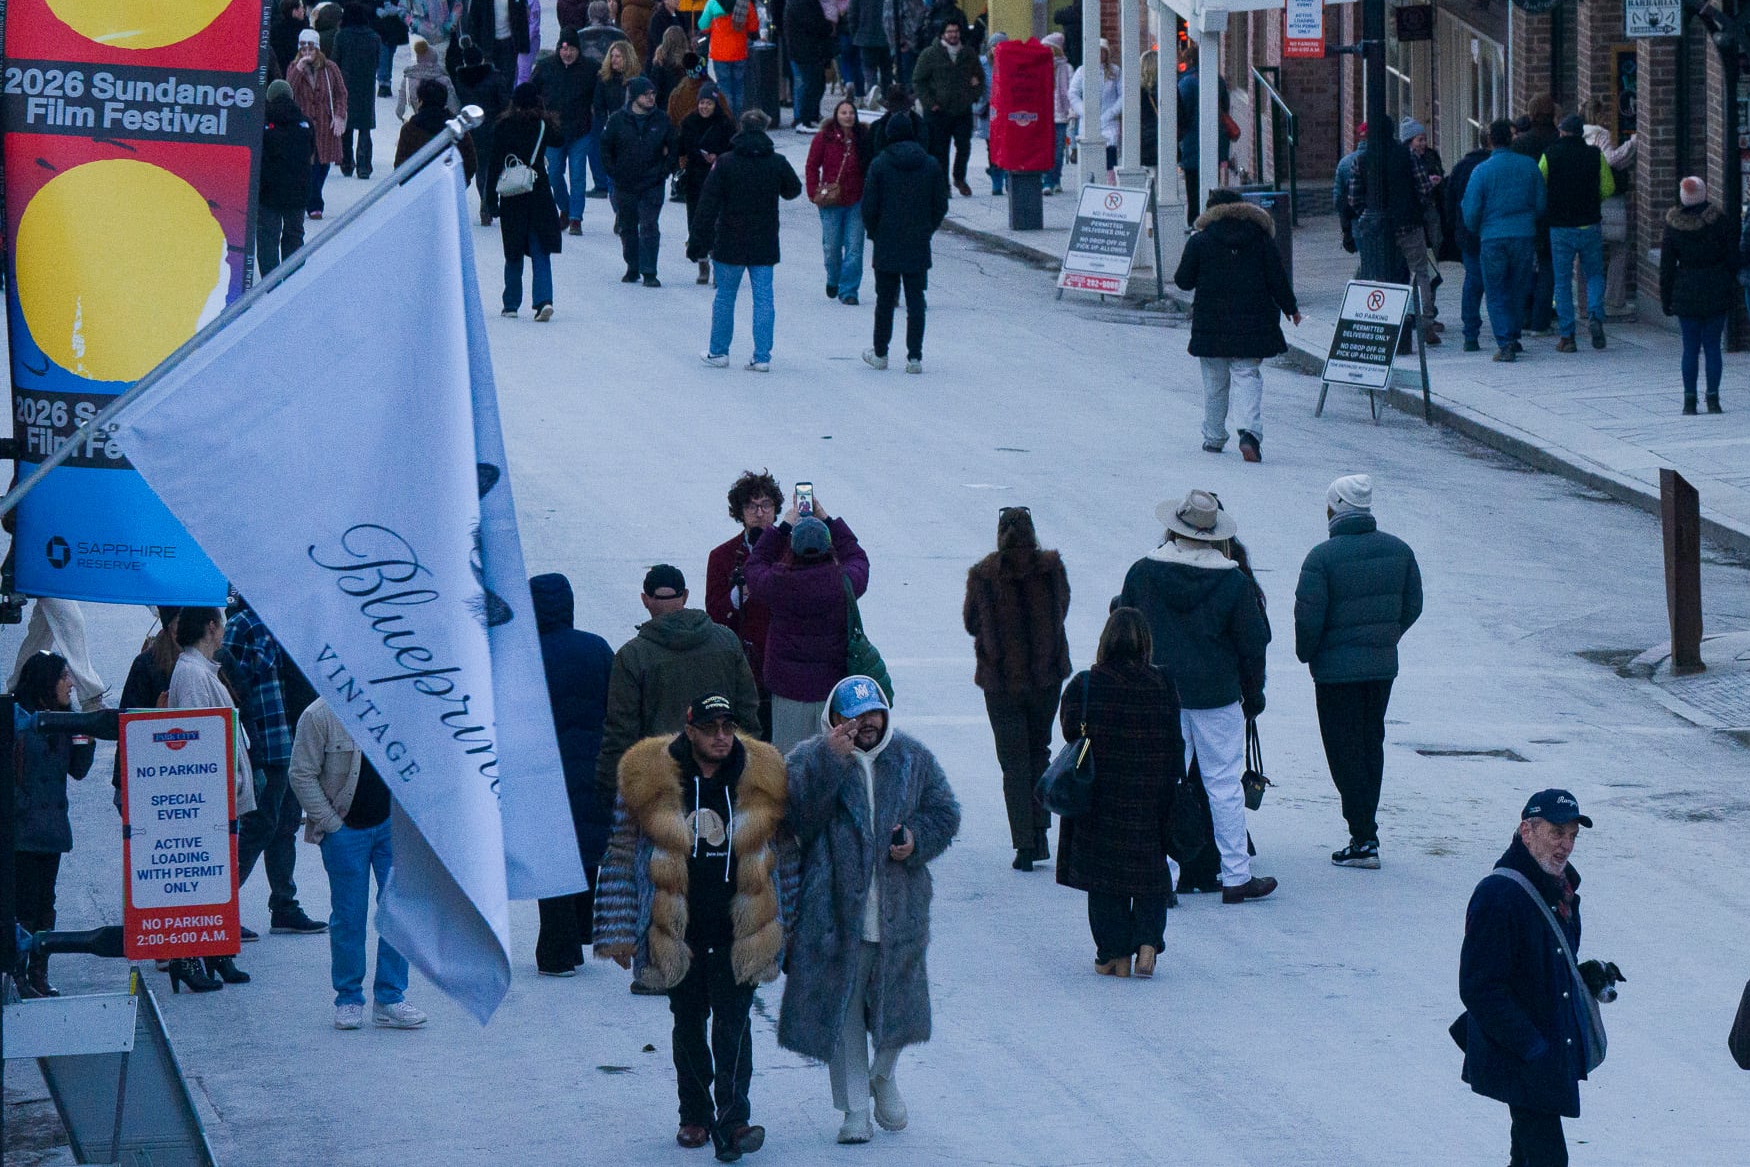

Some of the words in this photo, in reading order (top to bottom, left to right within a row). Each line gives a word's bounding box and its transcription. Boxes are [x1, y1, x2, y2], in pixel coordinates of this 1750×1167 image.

[4, 67, 85, 99] 2026
[91, 72, 255, 108] Sundance
[26, 97, 95, 128] Film
[103, 101, 228, 136] Festival
[1353, 324, 1385, 332] PERMITTED
[16, 395, 68, 427] 2026
[78, 542, 177, 559] SAPPHIRE
[78, 560, 142, 571] RESERVE
[316, 643, 421, 783] VINTAGE
[137, 767, 156, 778] NO
[160, 763, 218, 777] PARKING
[151, 793, 206, 806] SPECIAL
[157, 808, 200, 821] EVENT
[154, 837, 202, 851] ACTIVE
[151, 851, 209, 865] LOADING
[137, 868, 171, 881] WITH
[175, 865, 224, 879] PERMIT
[164, 882, 199, 894] ONLY
[142, 918, 161, 930] NO
[165, 915, 223, 928] PARKING
[136, 932, 197, 946] 2:00-6:00
[200, 930, 229, 943] A.M.
